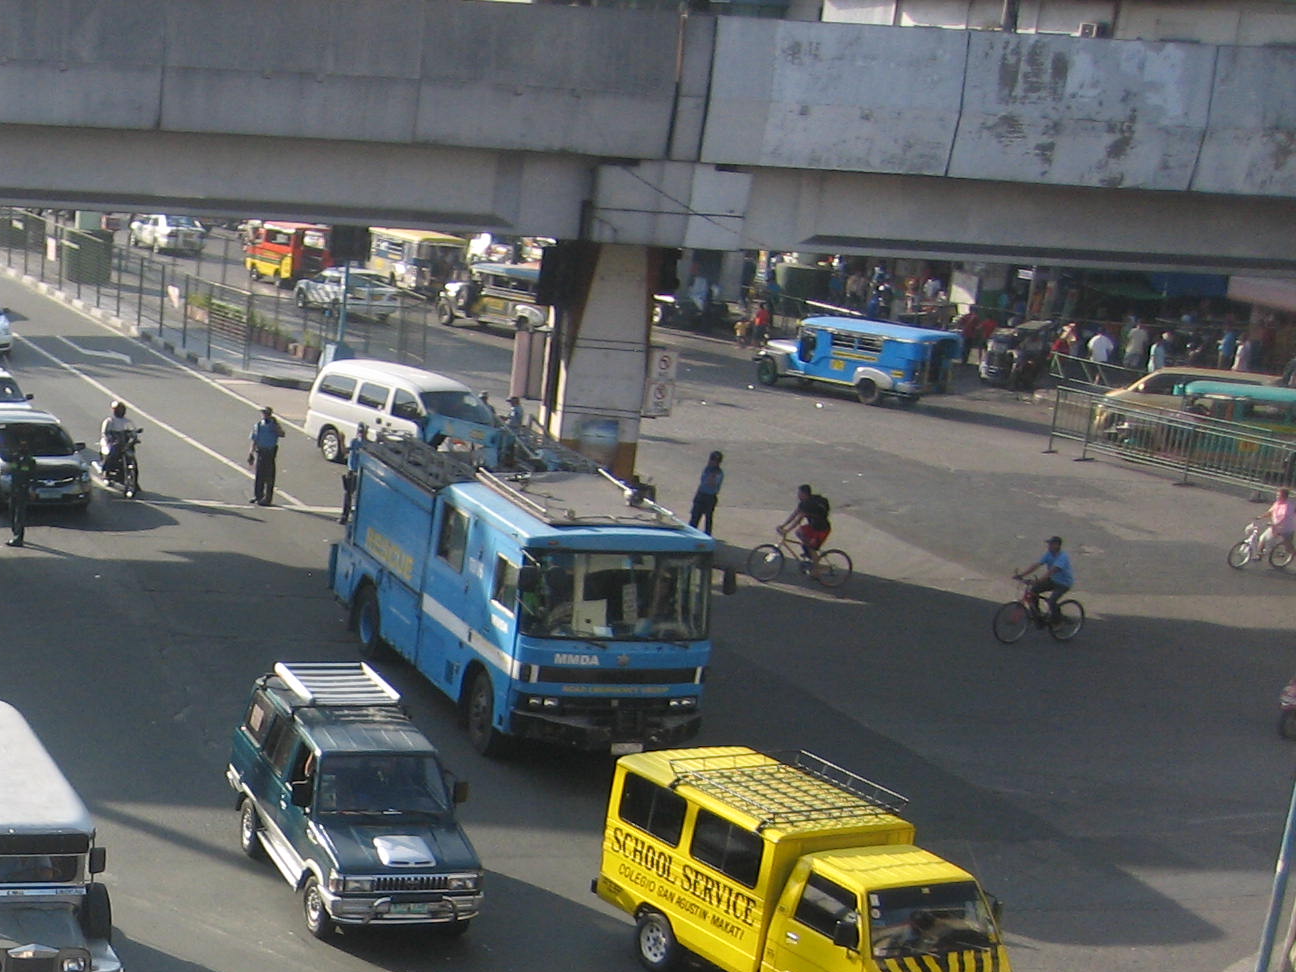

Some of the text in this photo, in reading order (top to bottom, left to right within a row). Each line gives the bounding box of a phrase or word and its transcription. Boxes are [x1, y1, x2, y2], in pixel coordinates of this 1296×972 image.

[365, 527, 415, 580] RESCUE
[554, 653, 600, 666] MMDA
[612, 827, 757, 927] SCHOOL SERVICE
[618, 863, 657, 893] COLEGIO
[657, 886, 677, 904] SAN
